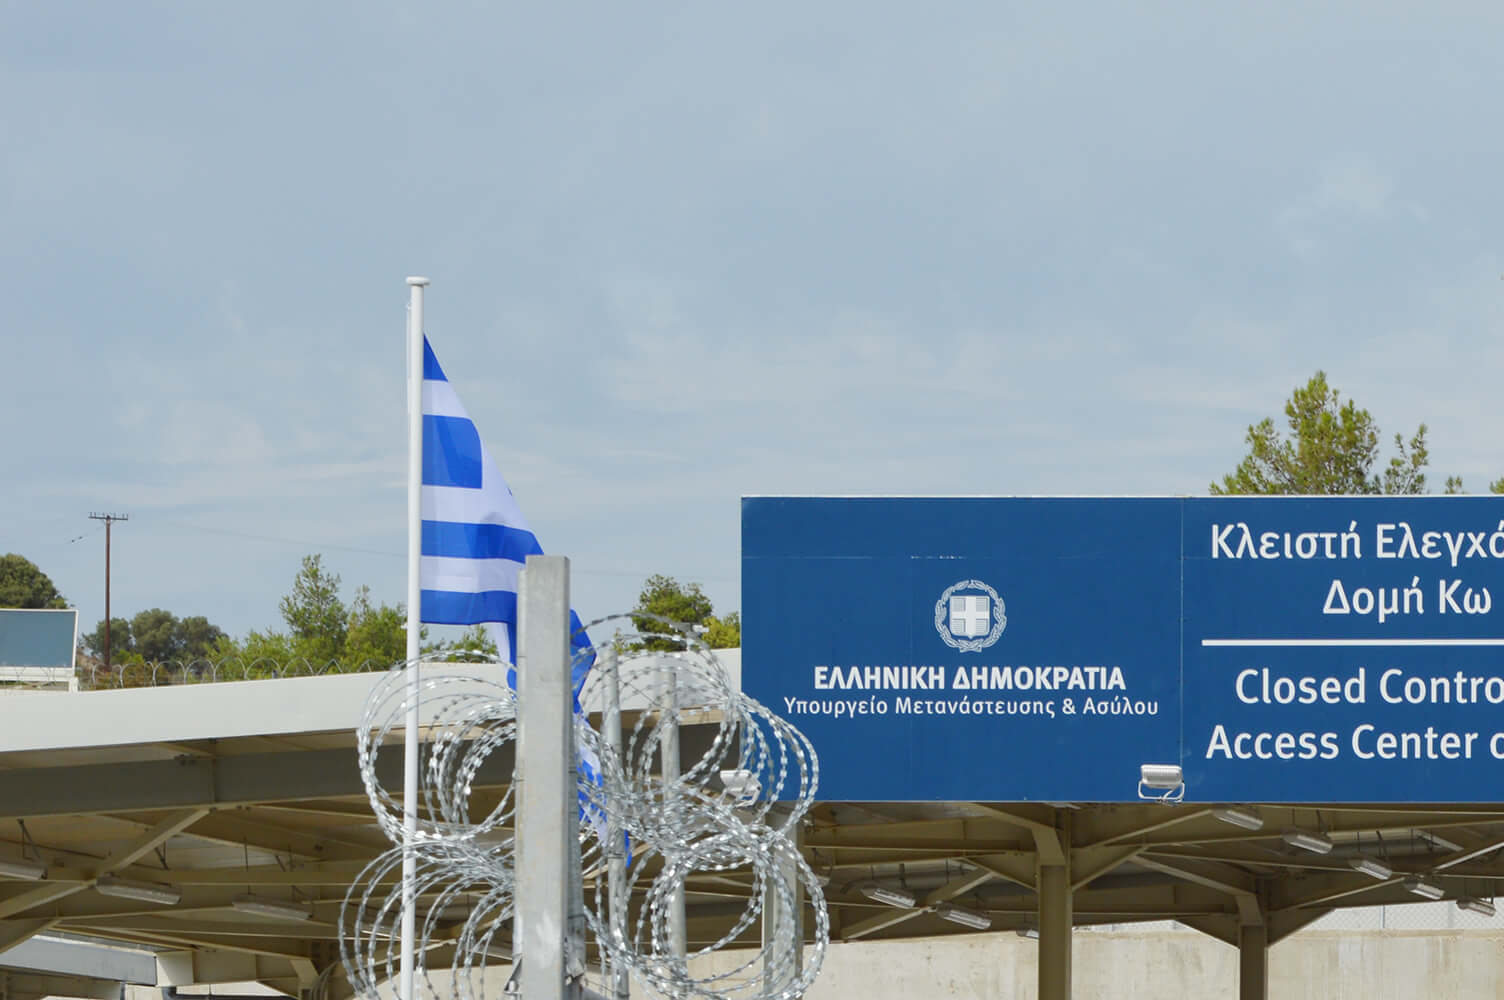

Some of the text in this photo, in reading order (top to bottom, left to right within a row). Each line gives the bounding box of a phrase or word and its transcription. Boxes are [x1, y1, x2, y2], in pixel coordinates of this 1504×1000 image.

[1212, 520, 1362, 559] Κλειστή
[1323, 575, 1492, 623] Δομή Κω
[814, 666, 1126, 690] ΕΛΛΗΝΙΚΗ ΔΗΜΟΚΡΑΤΙΑ
[1235, 667, 1366, 704] Closed
[784, 695, 1158, 719] Υπουργείο Μετανάστευσης & Ασύλου
[1205, 724, 1339, 760] Access
[1351, 724, 1479, 759] Center
